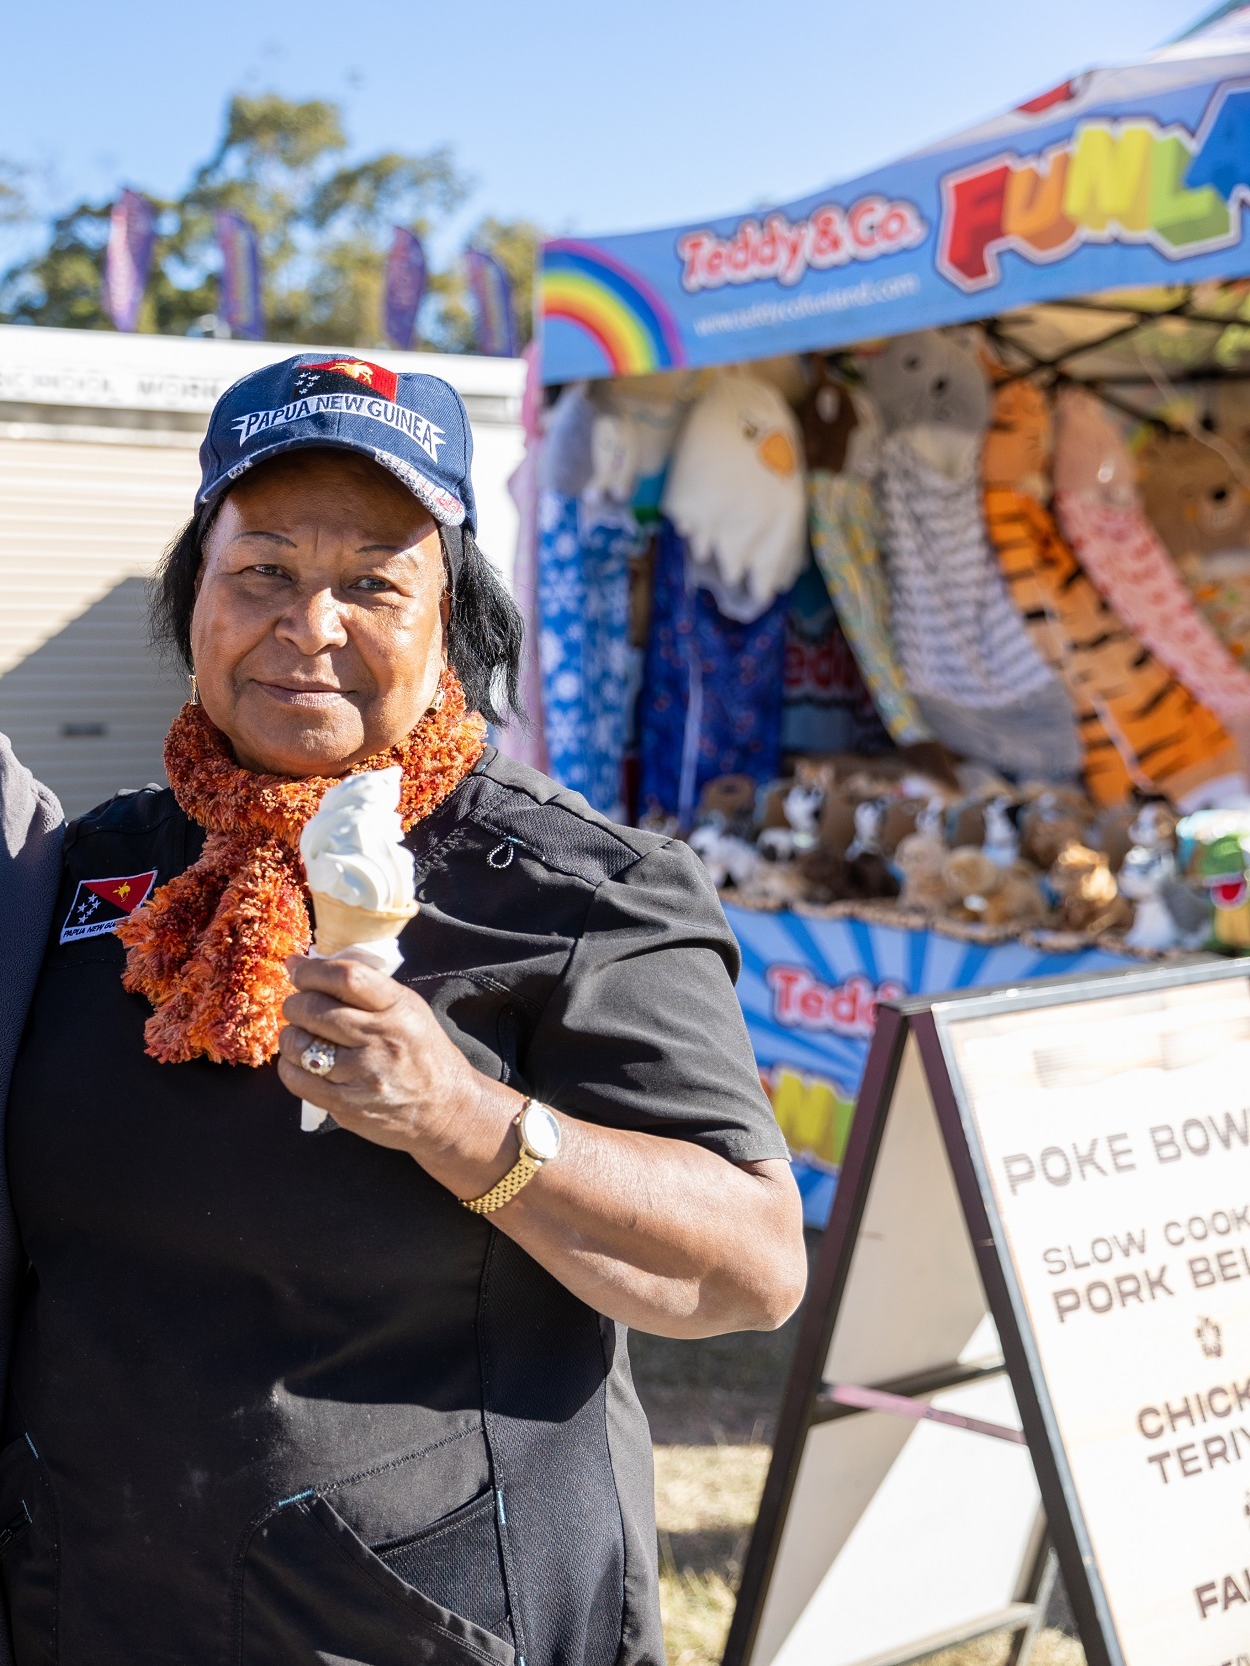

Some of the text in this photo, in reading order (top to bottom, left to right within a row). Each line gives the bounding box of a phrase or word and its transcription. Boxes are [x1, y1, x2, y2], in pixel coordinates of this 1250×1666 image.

[246, 395, 434, 455] PAPUA NEW GUINEA
[63, 928, 86, 938] PAPUA
[87, 923, 106, 933] NEW
[1002, 1132, 1137, 1197] POKE
[1042, 1227, 1146, 1276] SLOW
[1051, 1263, 1175, 1324] PORK
